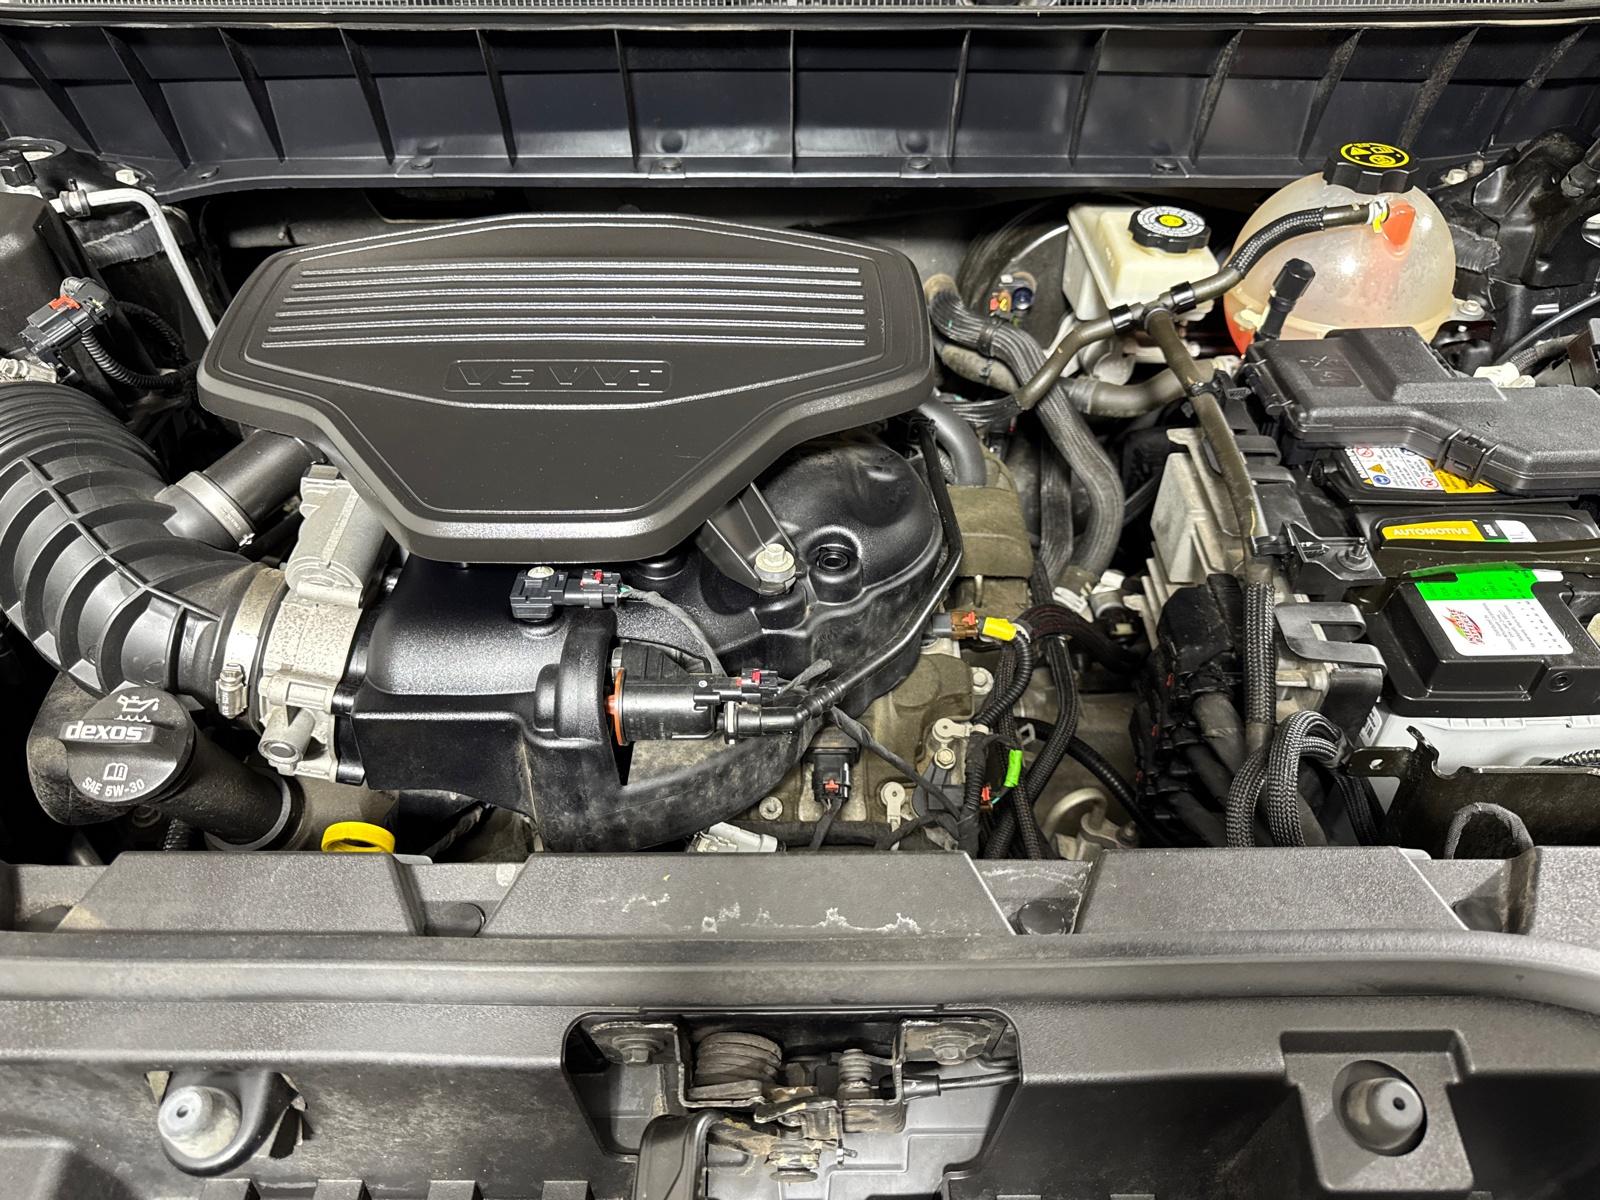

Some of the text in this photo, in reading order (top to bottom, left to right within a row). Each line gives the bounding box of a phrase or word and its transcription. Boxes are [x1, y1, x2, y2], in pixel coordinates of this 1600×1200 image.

[1393, 527, 1471, 537] AUTOMOTIVE
[65, 720, 144, 741] dexos
[82, 776, 145, 797] SAE 5W-30
